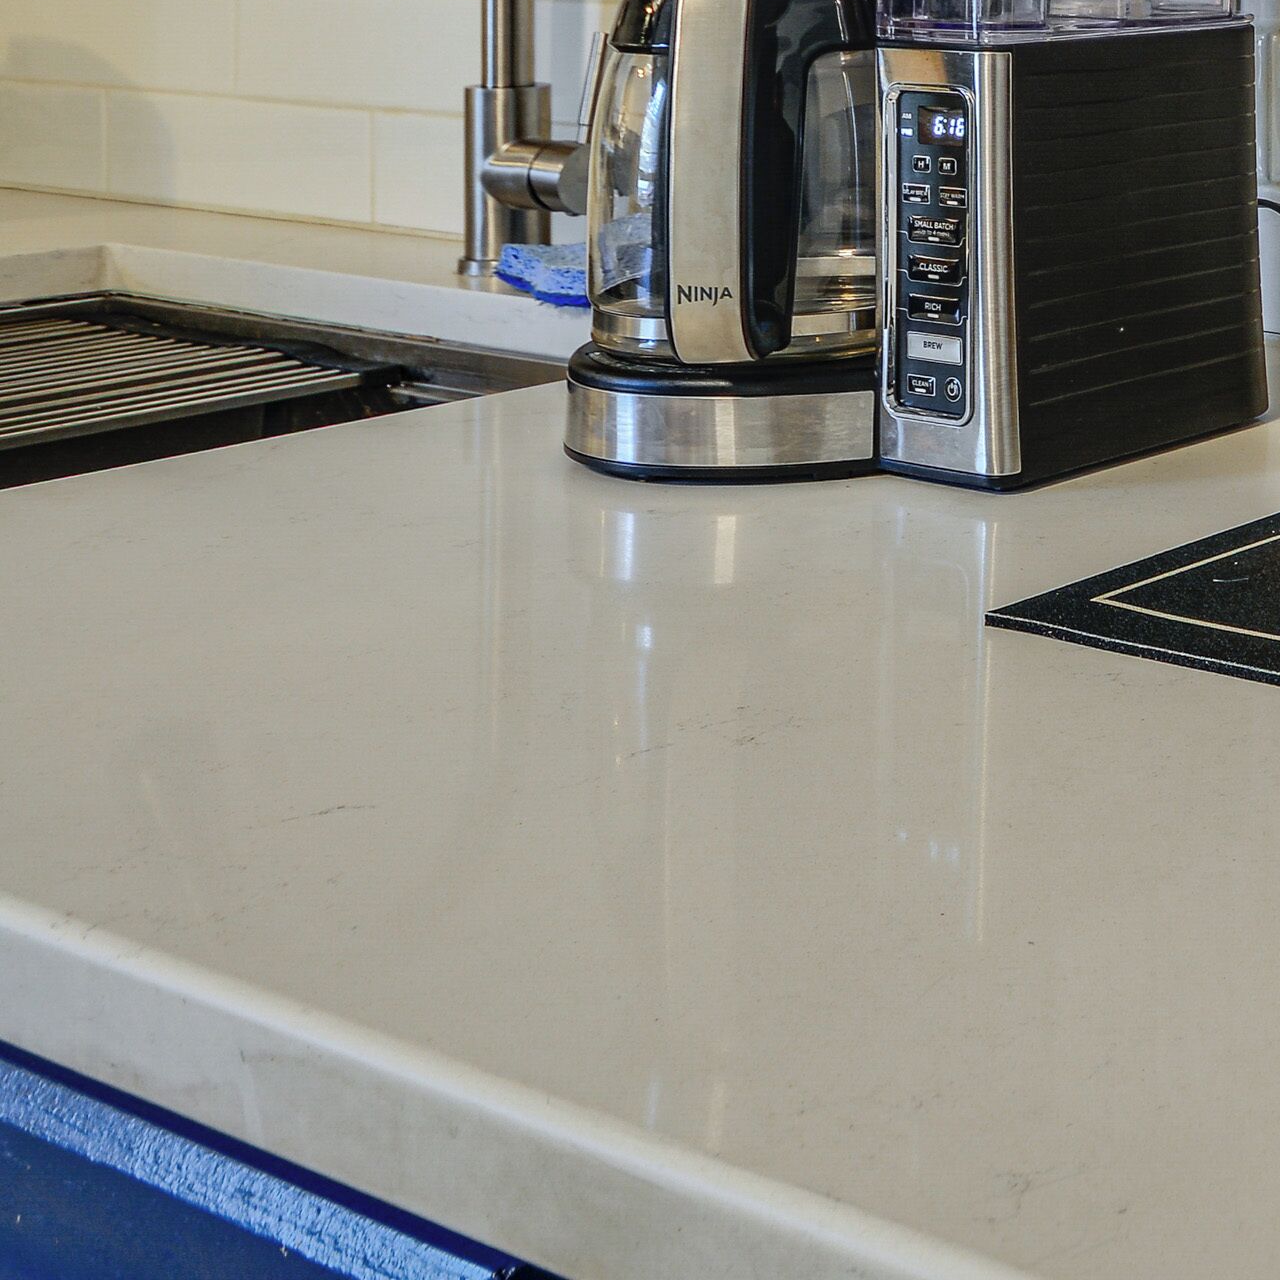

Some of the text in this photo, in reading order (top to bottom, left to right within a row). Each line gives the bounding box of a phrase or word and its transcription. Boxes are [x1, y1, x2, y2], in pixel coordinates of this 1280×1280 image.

[919, 262, 949, 274] CLASSIC
[677, 284, 733, 306] NINJA
[924, 301, 942, 312] RICH
[923, 340, 943, 351] BREW
